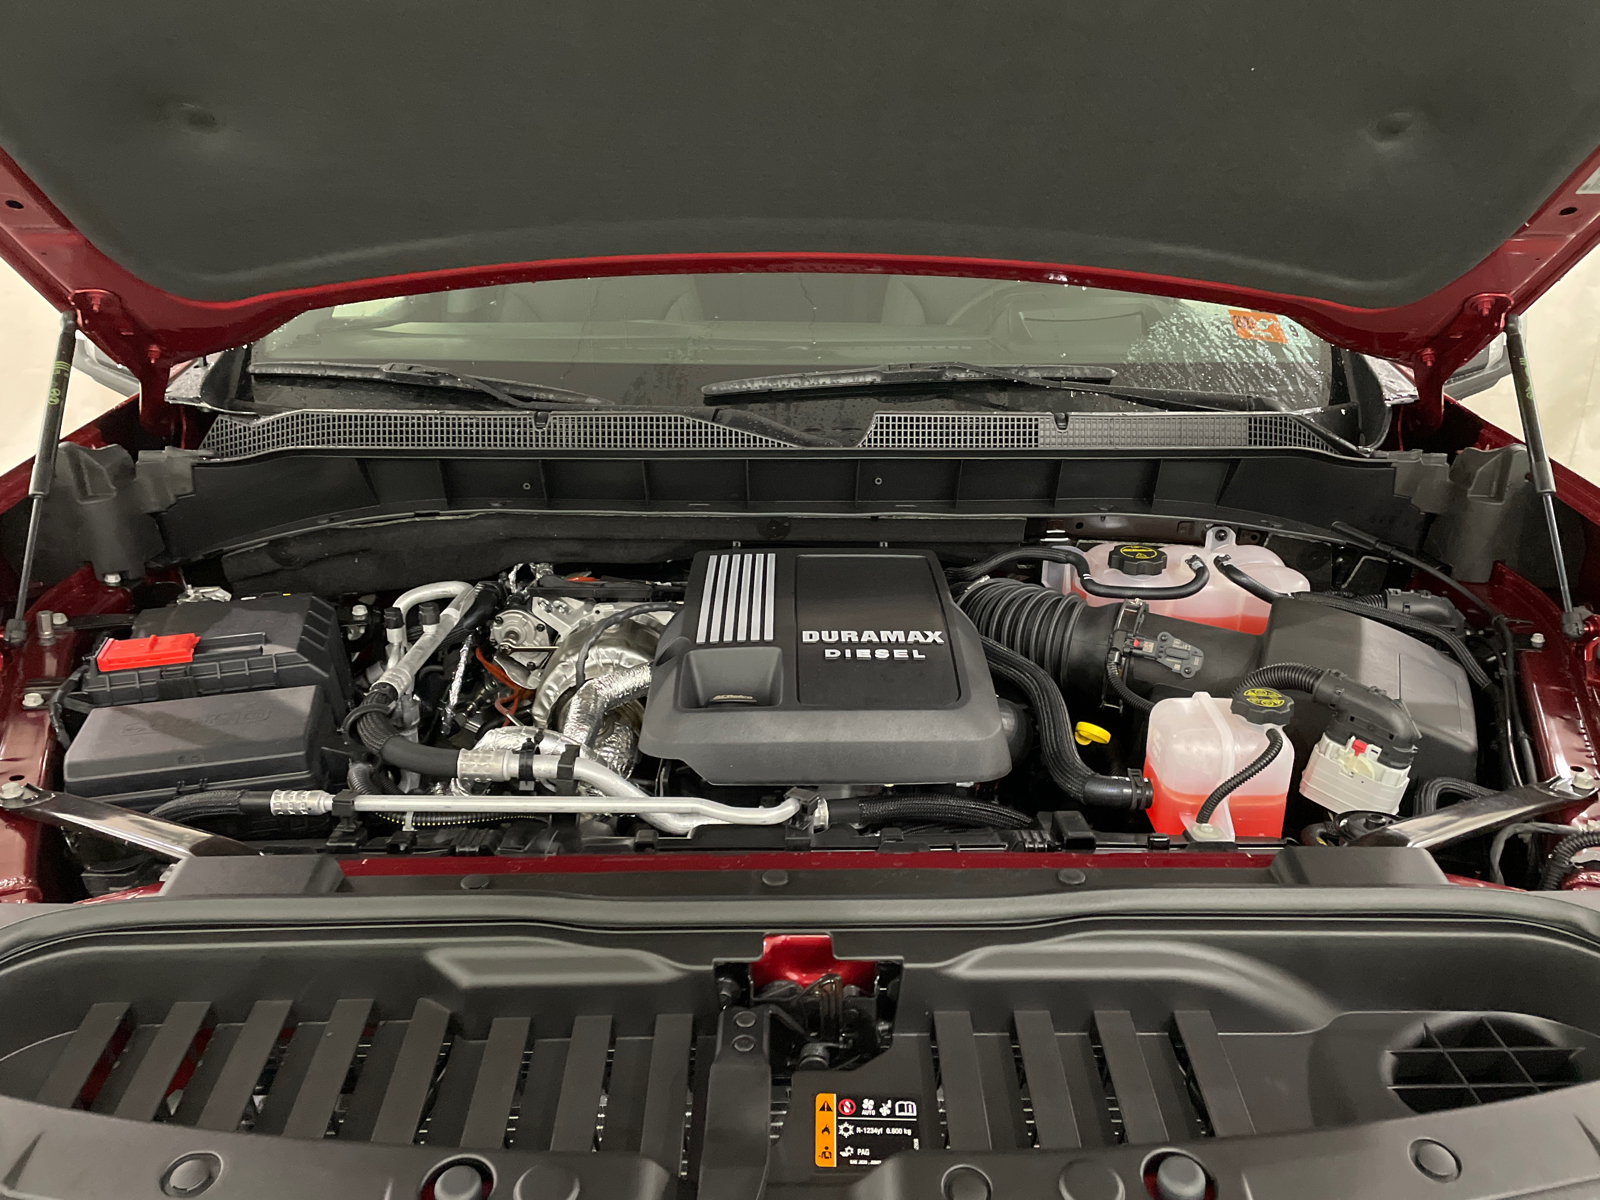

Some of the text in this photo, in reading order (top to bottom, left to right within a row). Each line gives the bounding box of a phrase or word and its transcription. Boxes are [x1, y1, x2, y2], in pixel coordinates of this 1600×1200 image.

[802, 630, 944, 645] DURAMAX
[824, 649, 926, 660] DIESEL
[856, 1127, 883, 1135] R-1234yf
[903, 1128, 912, 1136] kg
[857, 1148, 870, 1156] PAG
